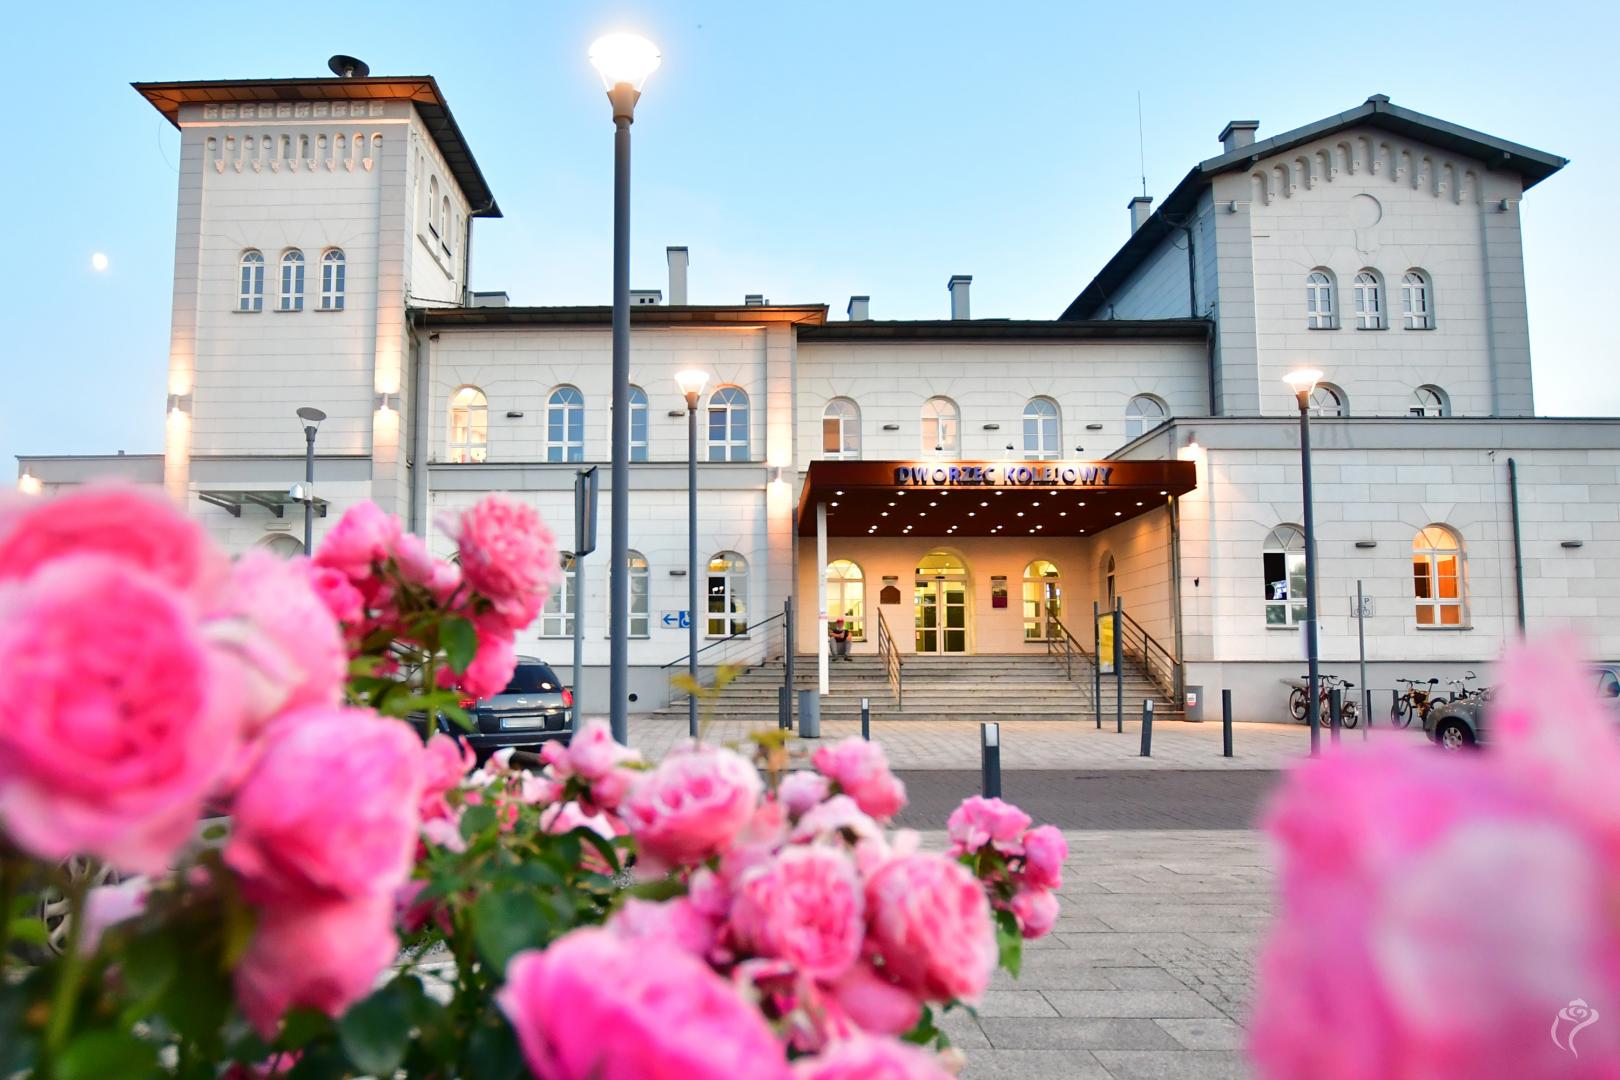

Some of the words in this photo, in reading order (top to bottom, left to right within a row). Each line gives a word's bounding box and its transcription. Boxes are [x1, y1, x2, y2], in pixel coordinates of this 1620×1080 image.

[897, 466, 996, 484] DWORZEC
[1003, 466, 1111, 484] KOLEJOWY
[1364, 597, 1370, 605] P
